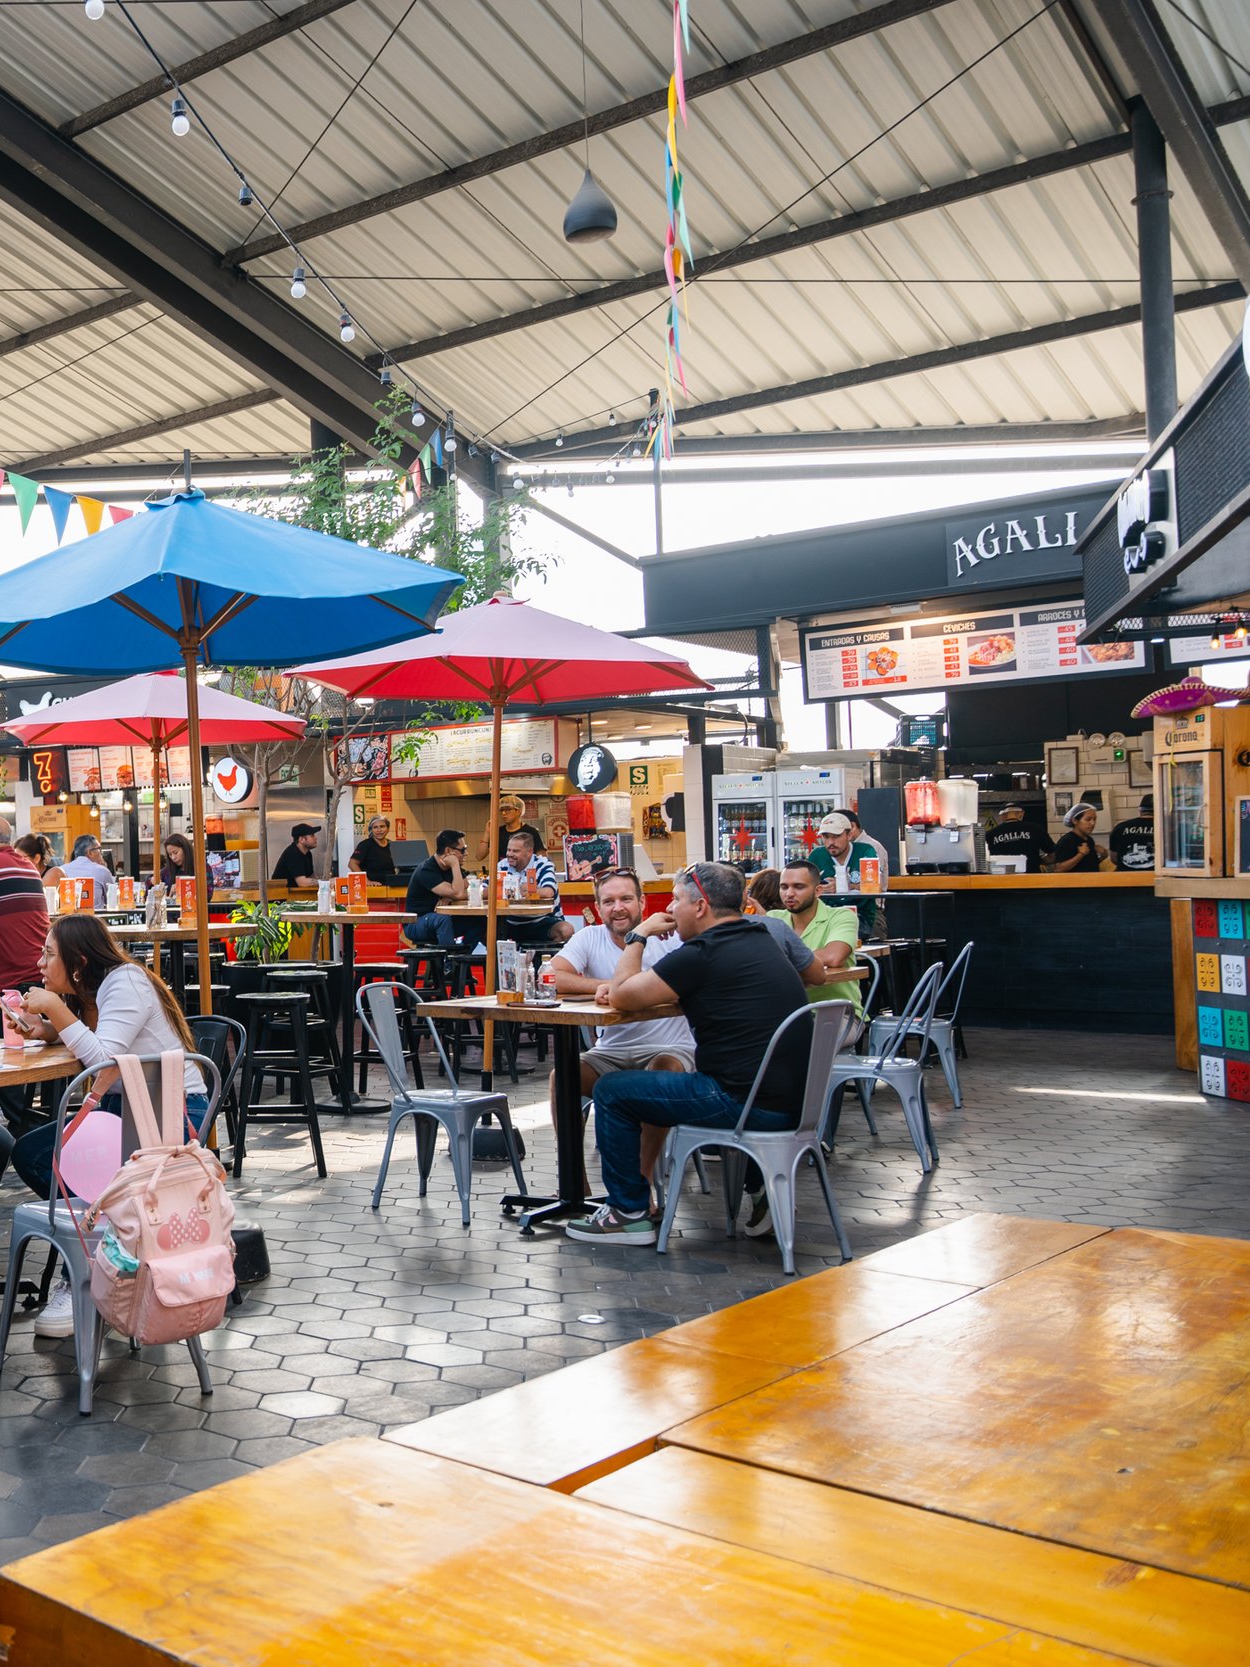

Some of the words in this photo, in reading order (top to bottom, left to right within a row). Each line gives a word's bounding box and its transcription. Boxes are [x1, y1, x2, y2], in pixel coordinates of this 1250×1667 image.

[1038, 610, 1072, 622] ARROCES
[942, 621, 976, 633] CEVICHES
[821, 636, 855, 647] ENTRADAS
[856, 635, 862, 643] Y
[863, 632, 890, 643] CAUSAS
[1165, 730, 1198, 747] Corona
[632, 767, 646, 783] S
[354, 806, 364, 823] S
[993, 831, 1030, 845] AGALLAS
